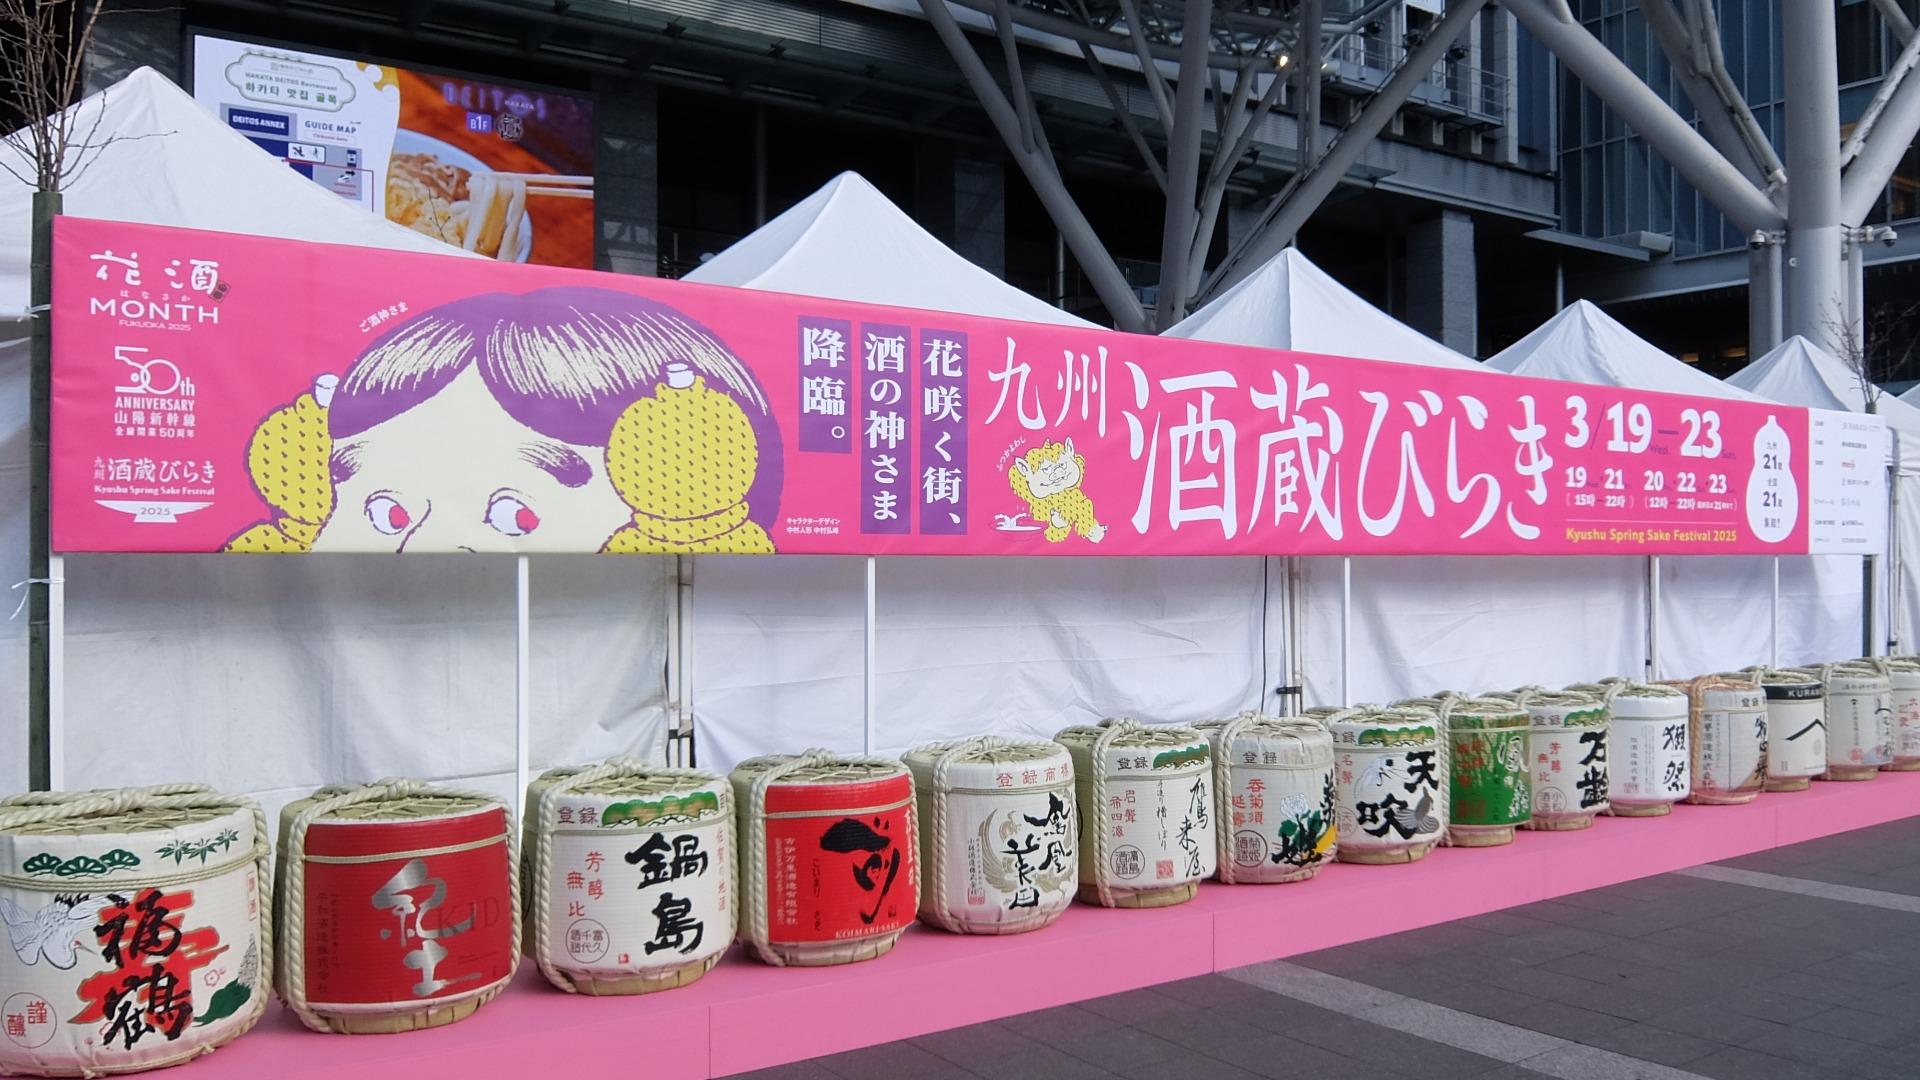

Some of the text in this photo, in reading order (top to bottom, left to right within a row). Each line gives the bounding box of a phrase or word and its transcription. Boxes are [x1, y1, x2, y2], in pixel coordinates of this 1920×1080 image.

[245, 82, 280, 97] 하카타
[232, 115, 286, 129] DEITOS ANNEX
[304, 120, 357, 134] GUIDE MAP
[470, 115, 489, 131] B1F
[90, 297, 219, 324] MONTH
[119, 319, 191, 331] FUKUOKA 2025
[115, 346, 195, 396] 50th
[803, 327, 846, 439] 降臨。
[115, 397, 195, 412] ANNIVERSARY
[114, 410, 196, 428] 山陽新幹線
[864, 333, 906, 520] 酒の神さま
[923, 339, 963, 524] 花咲く街、
[985, 337, 1554, 541] 九州 酒蔵びらき
[108, 457, 215, 484] 酒蔵びらき
[1566, 467, 1727, 494] 19 21 20 22 23
[94, 485, 215, 497] Kyushu Spring Sake Festival
[140, 507, 170, 516] 2025
[1566, 528, 1737, 543] Kyushu Spring Sake Festival 2025
[1356, 750, 1439, 840] 天吹
[624, 832, 708, 955] 鍋島
